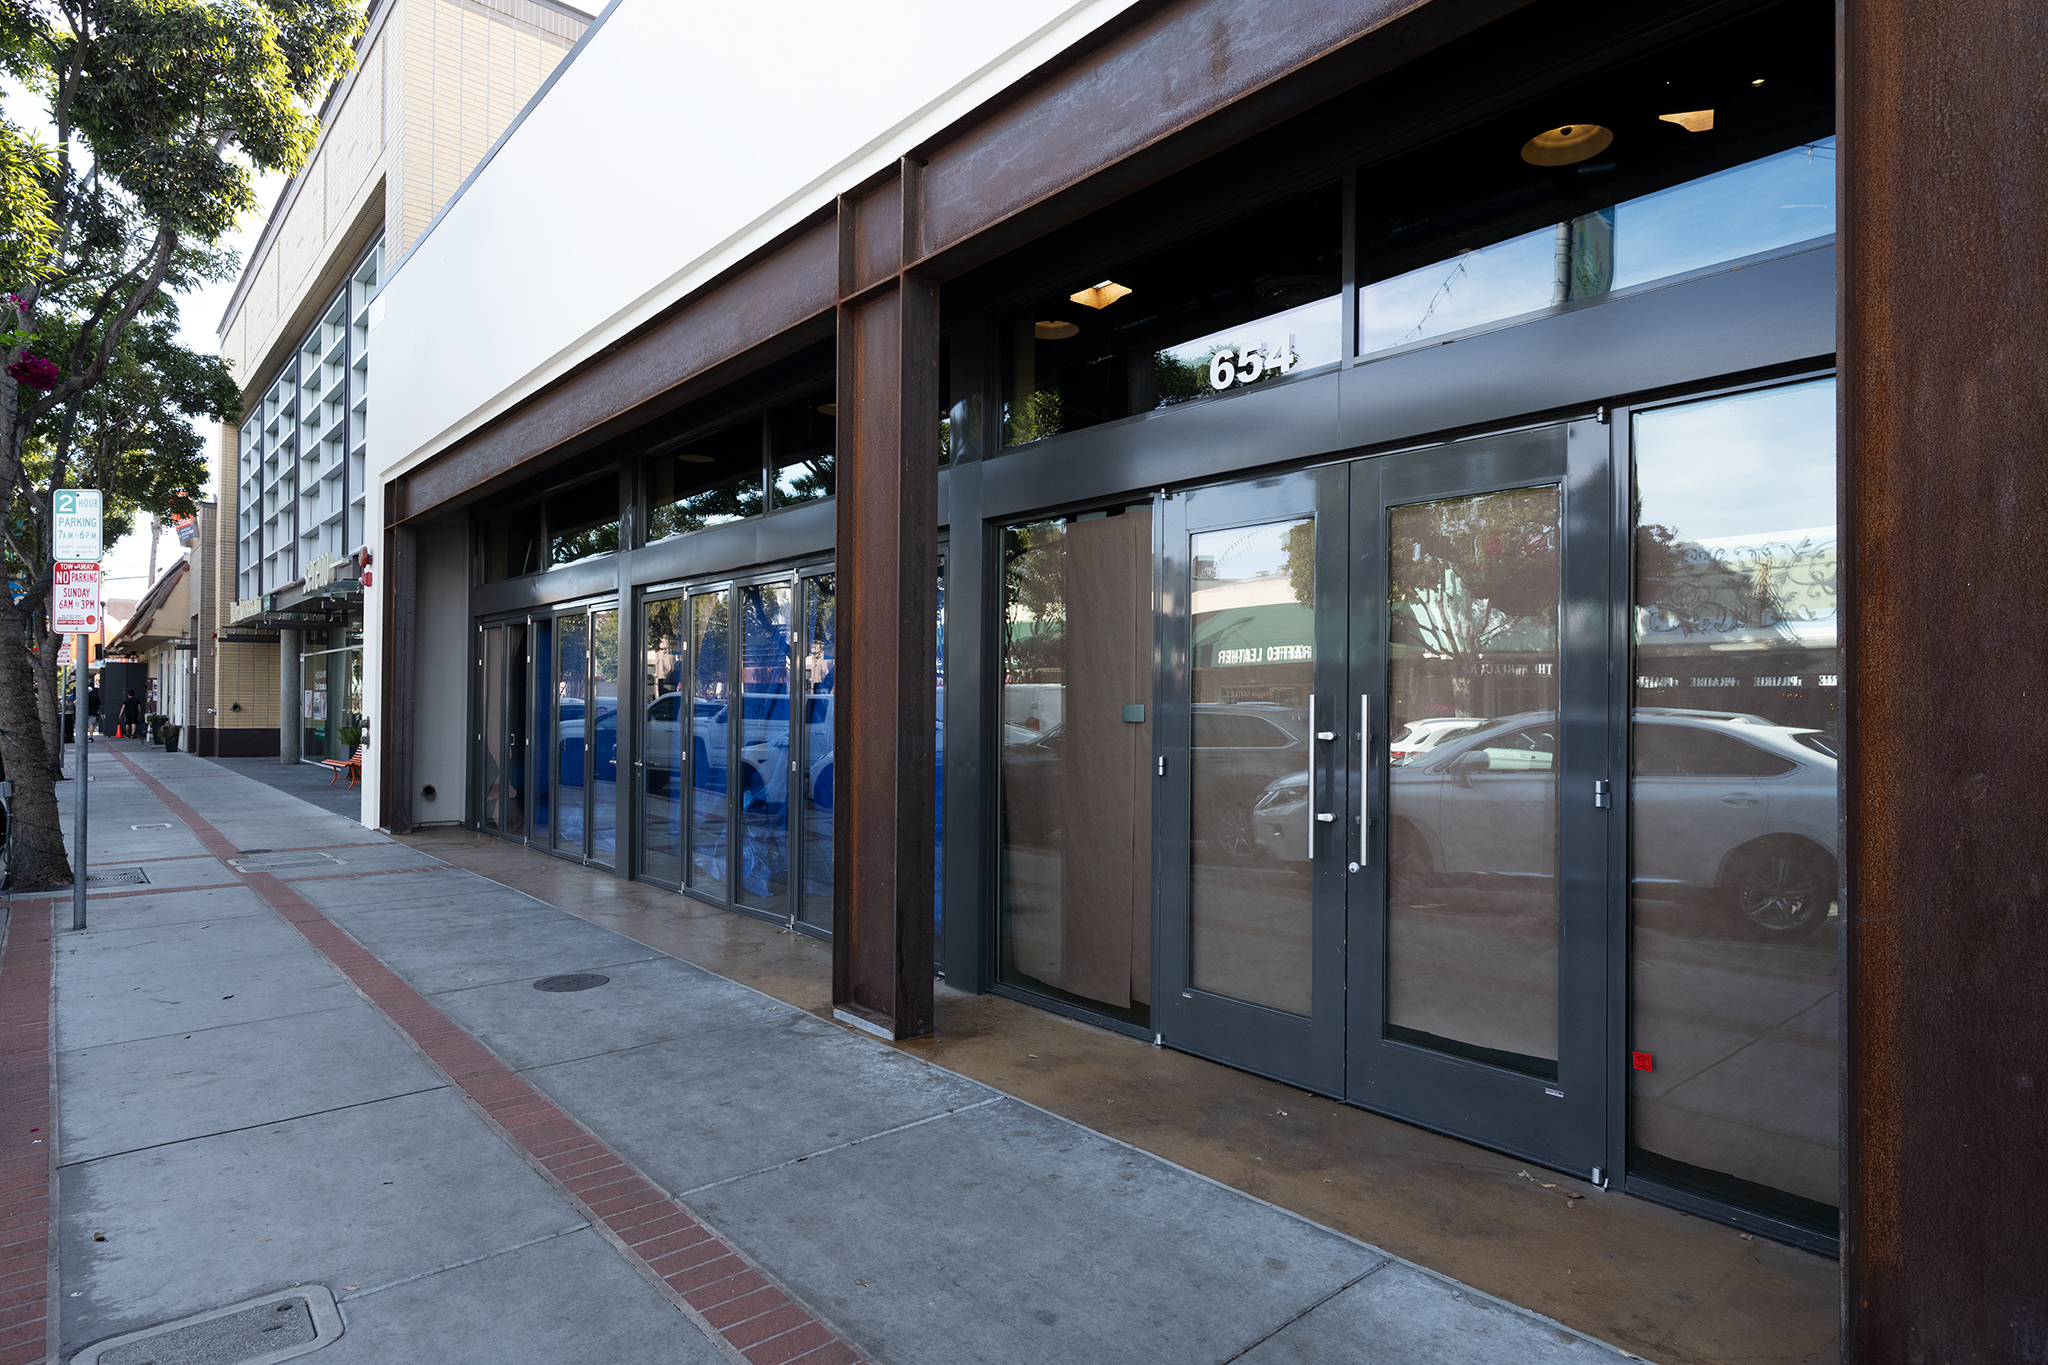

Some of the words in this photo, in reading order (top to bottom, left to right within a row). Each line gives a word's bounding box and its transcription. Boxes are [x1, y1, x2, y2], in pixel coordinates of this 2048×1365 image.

[1209, 331, 1294, 390] 654
[59, 494, 73, 512] 2
[78, 498, 98, 508] HOUR
[58, 517, 97, 528] PARKING
[56, 571, 69, 584] NO
[71, 572, 98, 583] PARKING
[63, 587, 91, 598] SUNDAY
[58, 599, 74, 610] 6AM
[80, 599, 95, 610] 3PM
